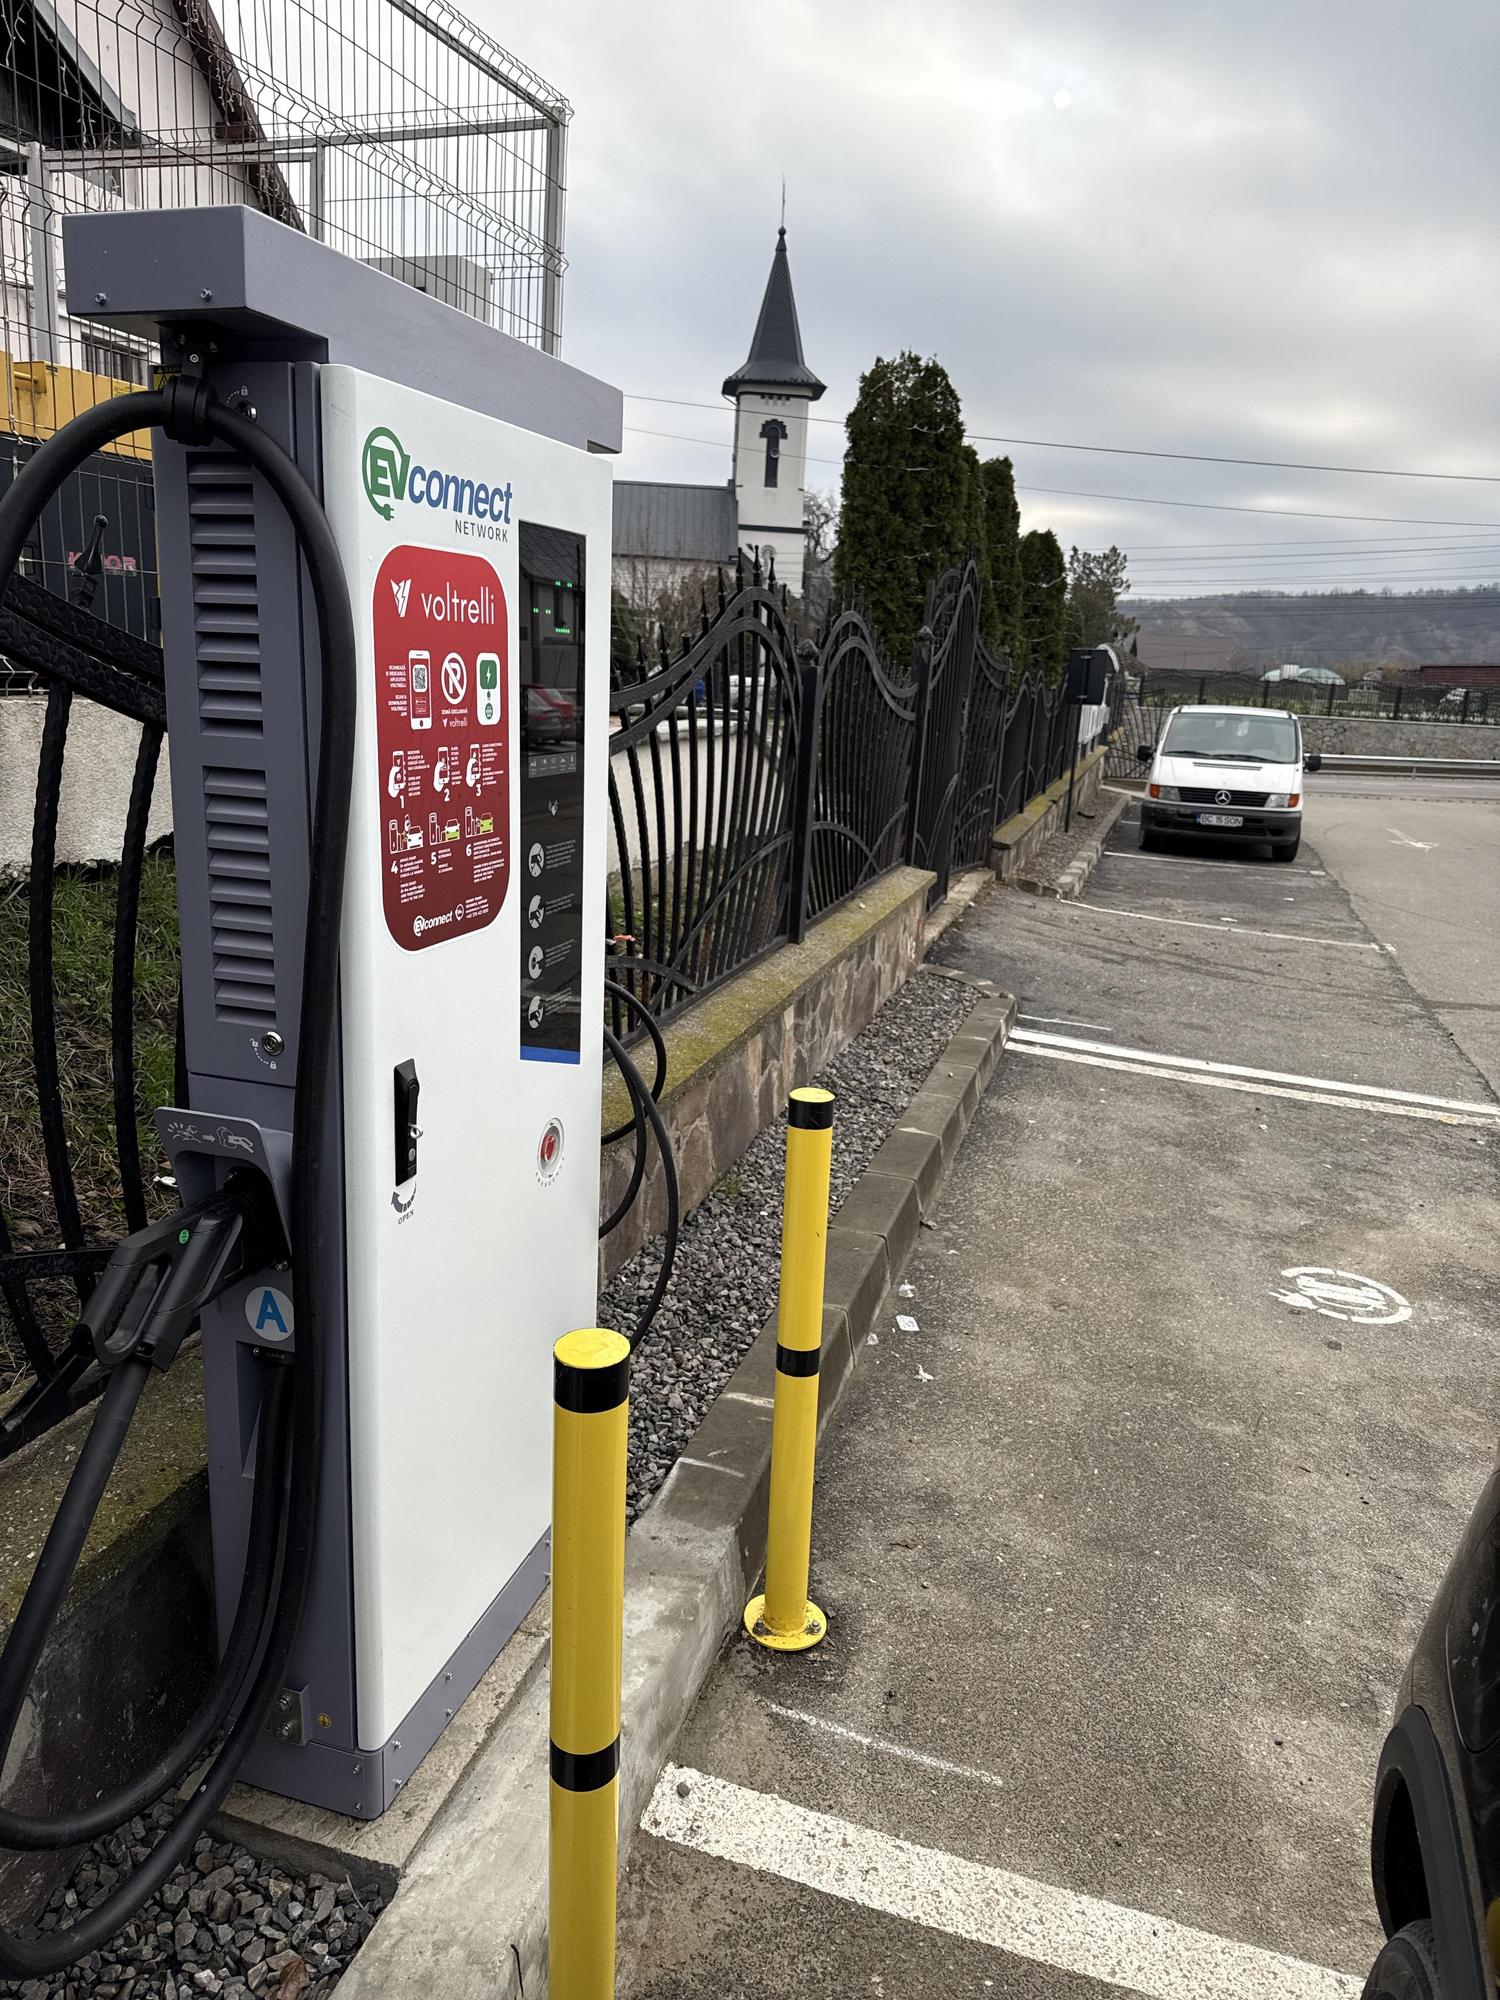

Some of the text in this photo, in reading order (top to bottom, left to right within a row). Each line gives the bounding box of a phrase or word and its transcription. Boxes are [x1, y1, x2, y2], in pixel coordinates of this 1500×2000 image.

[455, 519, 508, 543] NETWORK
[421, 582, 495, 625] voltrelli
[444, 788, 450, 802] 2
[476, 784, 481, 797] 3
[400, 795, 404, 808] 1
[466, 844, 472, 857] 6
[431, 852, 437, 865] 5
[391, 861, 398, 874] 4
[398, 1209, 415, 1225] OPEN
[255, 1290, 289, 1333] A
